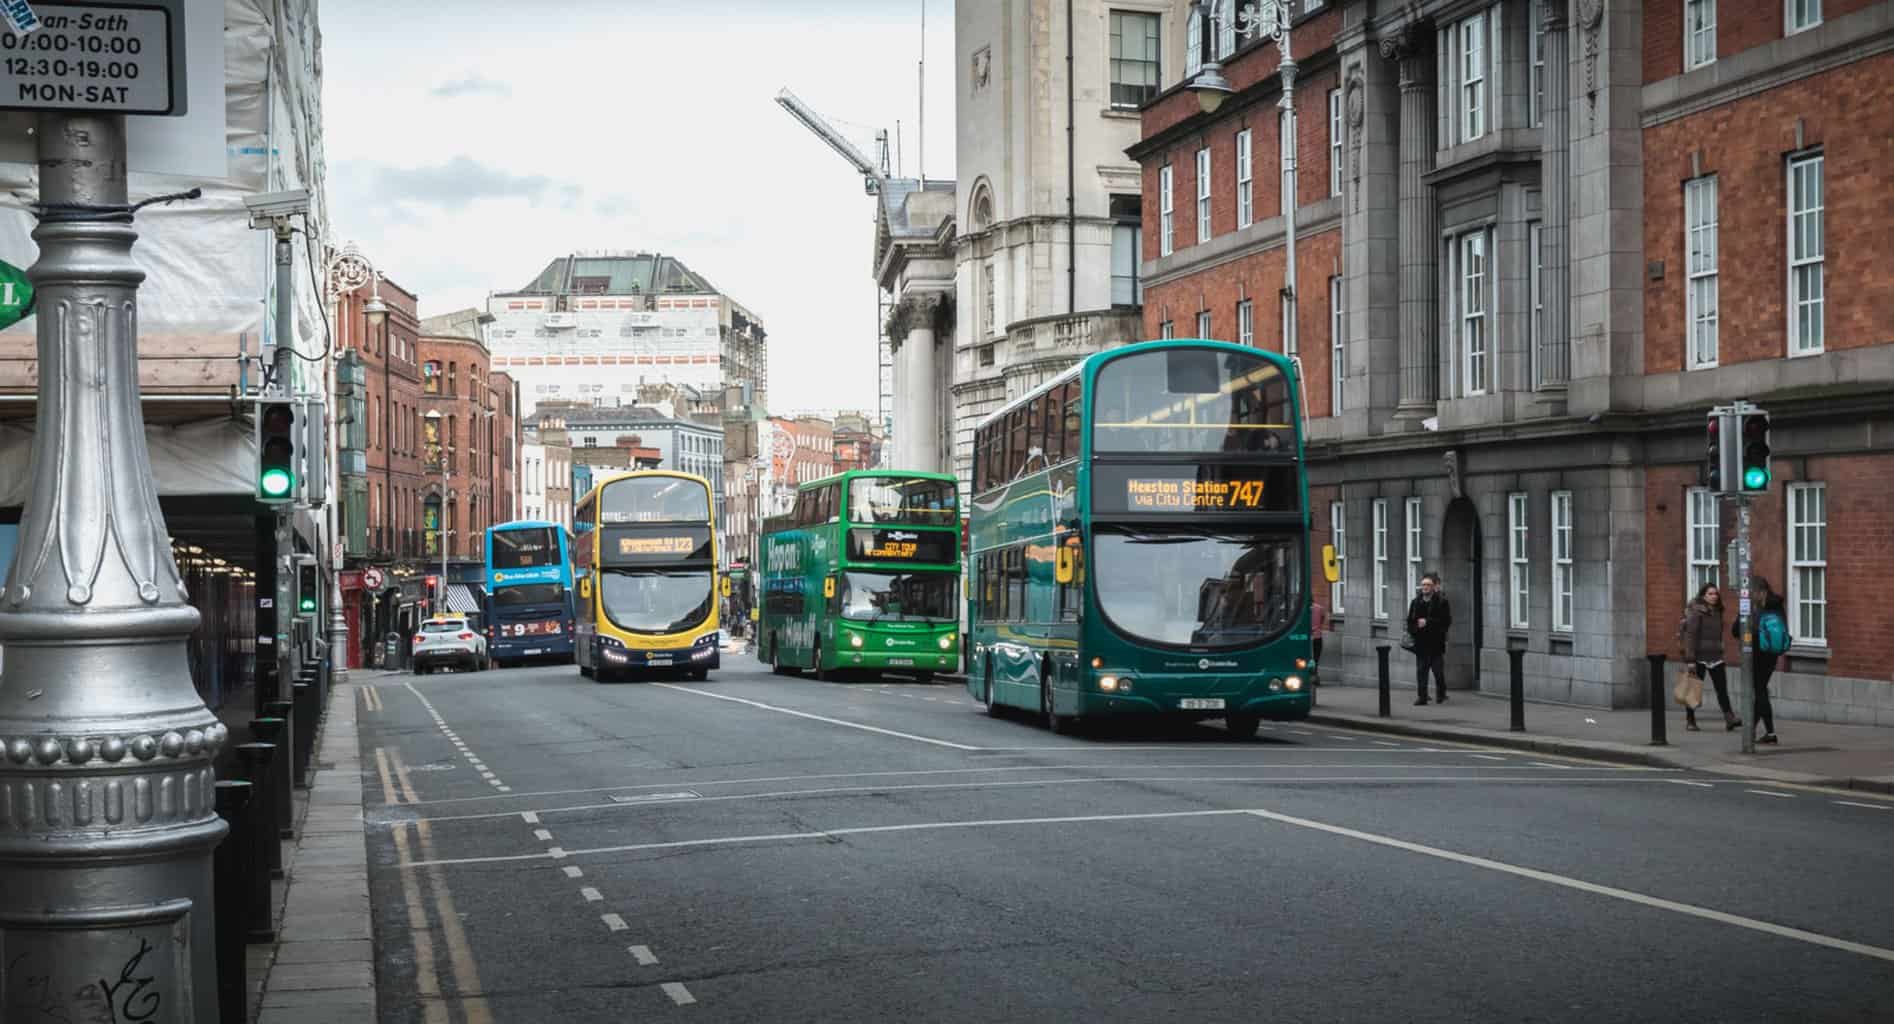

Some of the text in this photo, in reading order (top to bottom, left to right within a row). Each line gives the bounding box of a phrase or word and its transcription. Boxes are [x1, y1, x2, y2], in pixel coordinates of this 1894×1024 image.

[39, 13, 128, 32] an-Sath
[2, 33, 141, 54] 07:00-10:00
[5, 58, 139, 79] 12:30-19:00
[19, 83, 128, 104] MON-SAT
[1182, 480, 1228, 494] Station
[1229, 480, 1264, 507] 747
[1183, 493, 1224, 506] Centre
